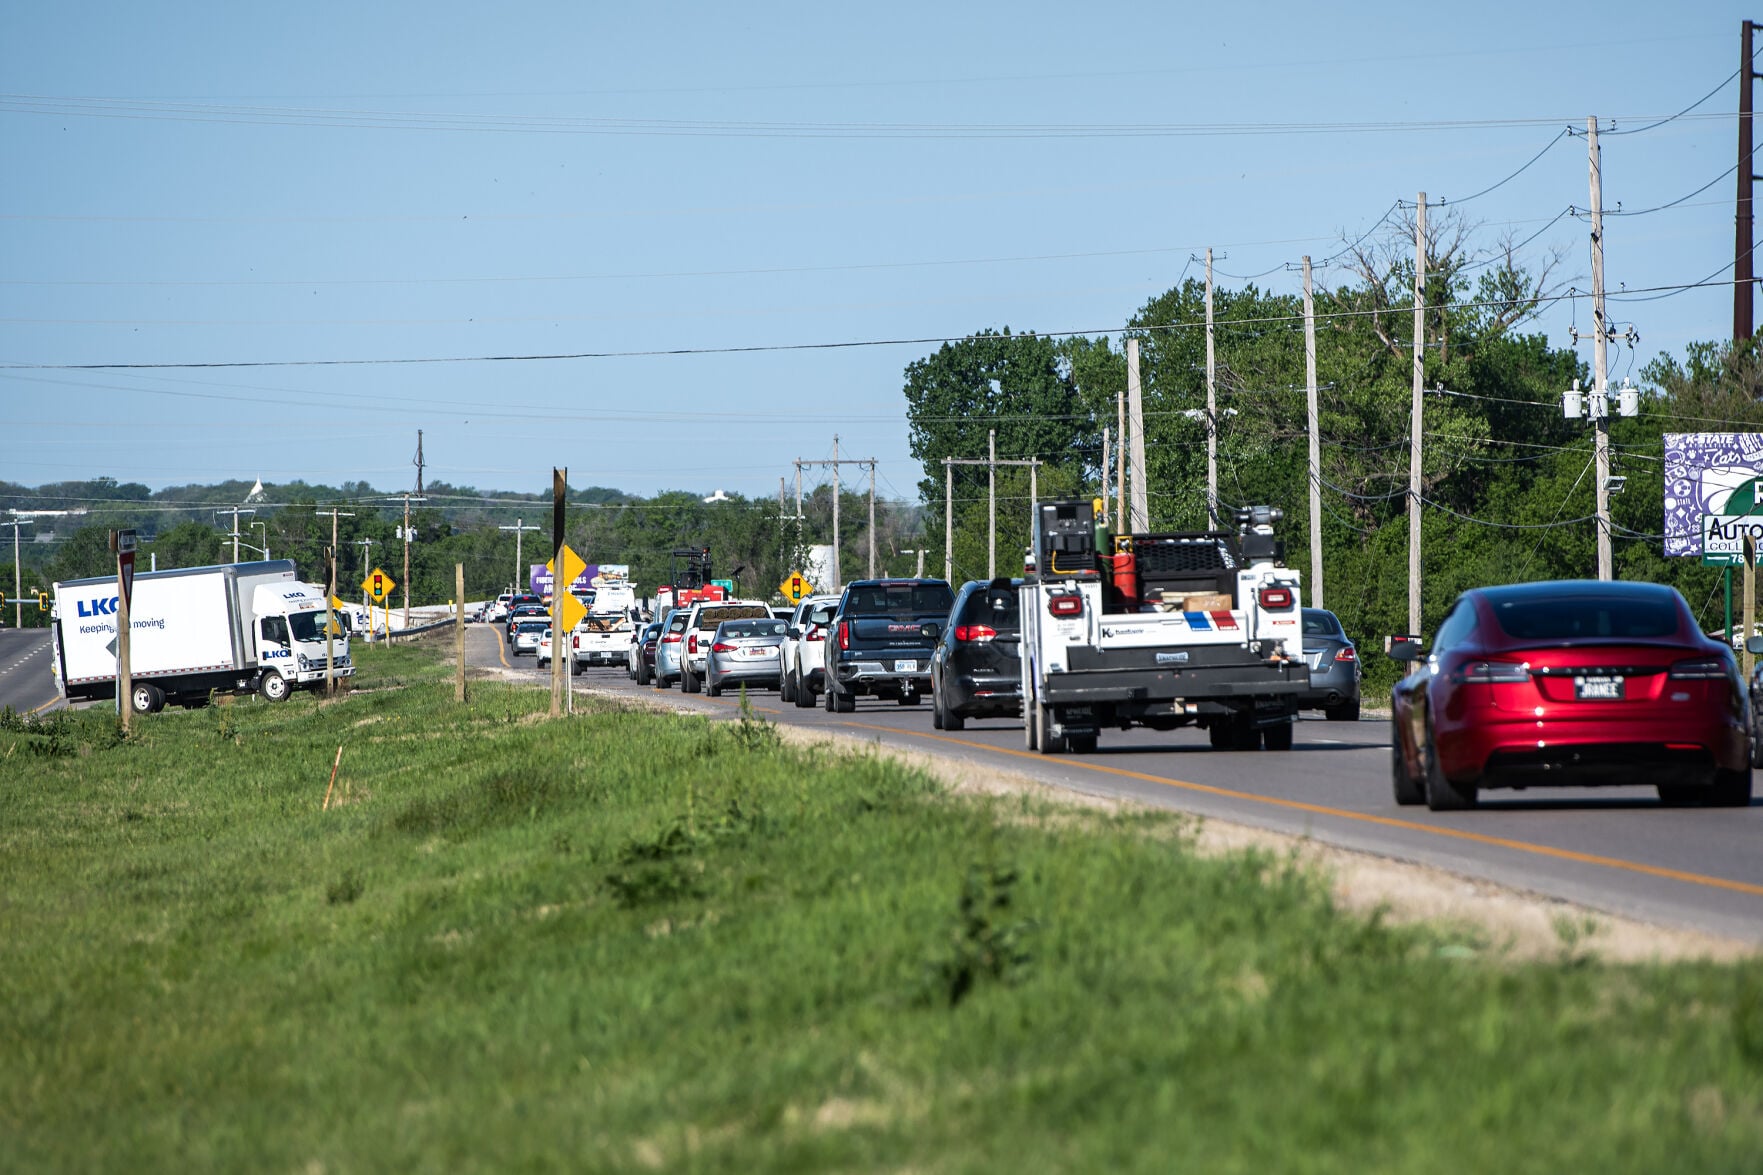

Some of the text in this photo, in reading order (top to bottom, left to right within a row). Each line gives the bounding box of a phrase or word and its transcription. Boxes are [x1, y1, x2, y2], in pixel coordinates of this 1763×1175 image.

[1711, 448, 1741, 466] Cats
[79, 623, 115, 634] Keeping
[133, 618, 165, 630] moving
[264, 649, 289, 659] LKQ
